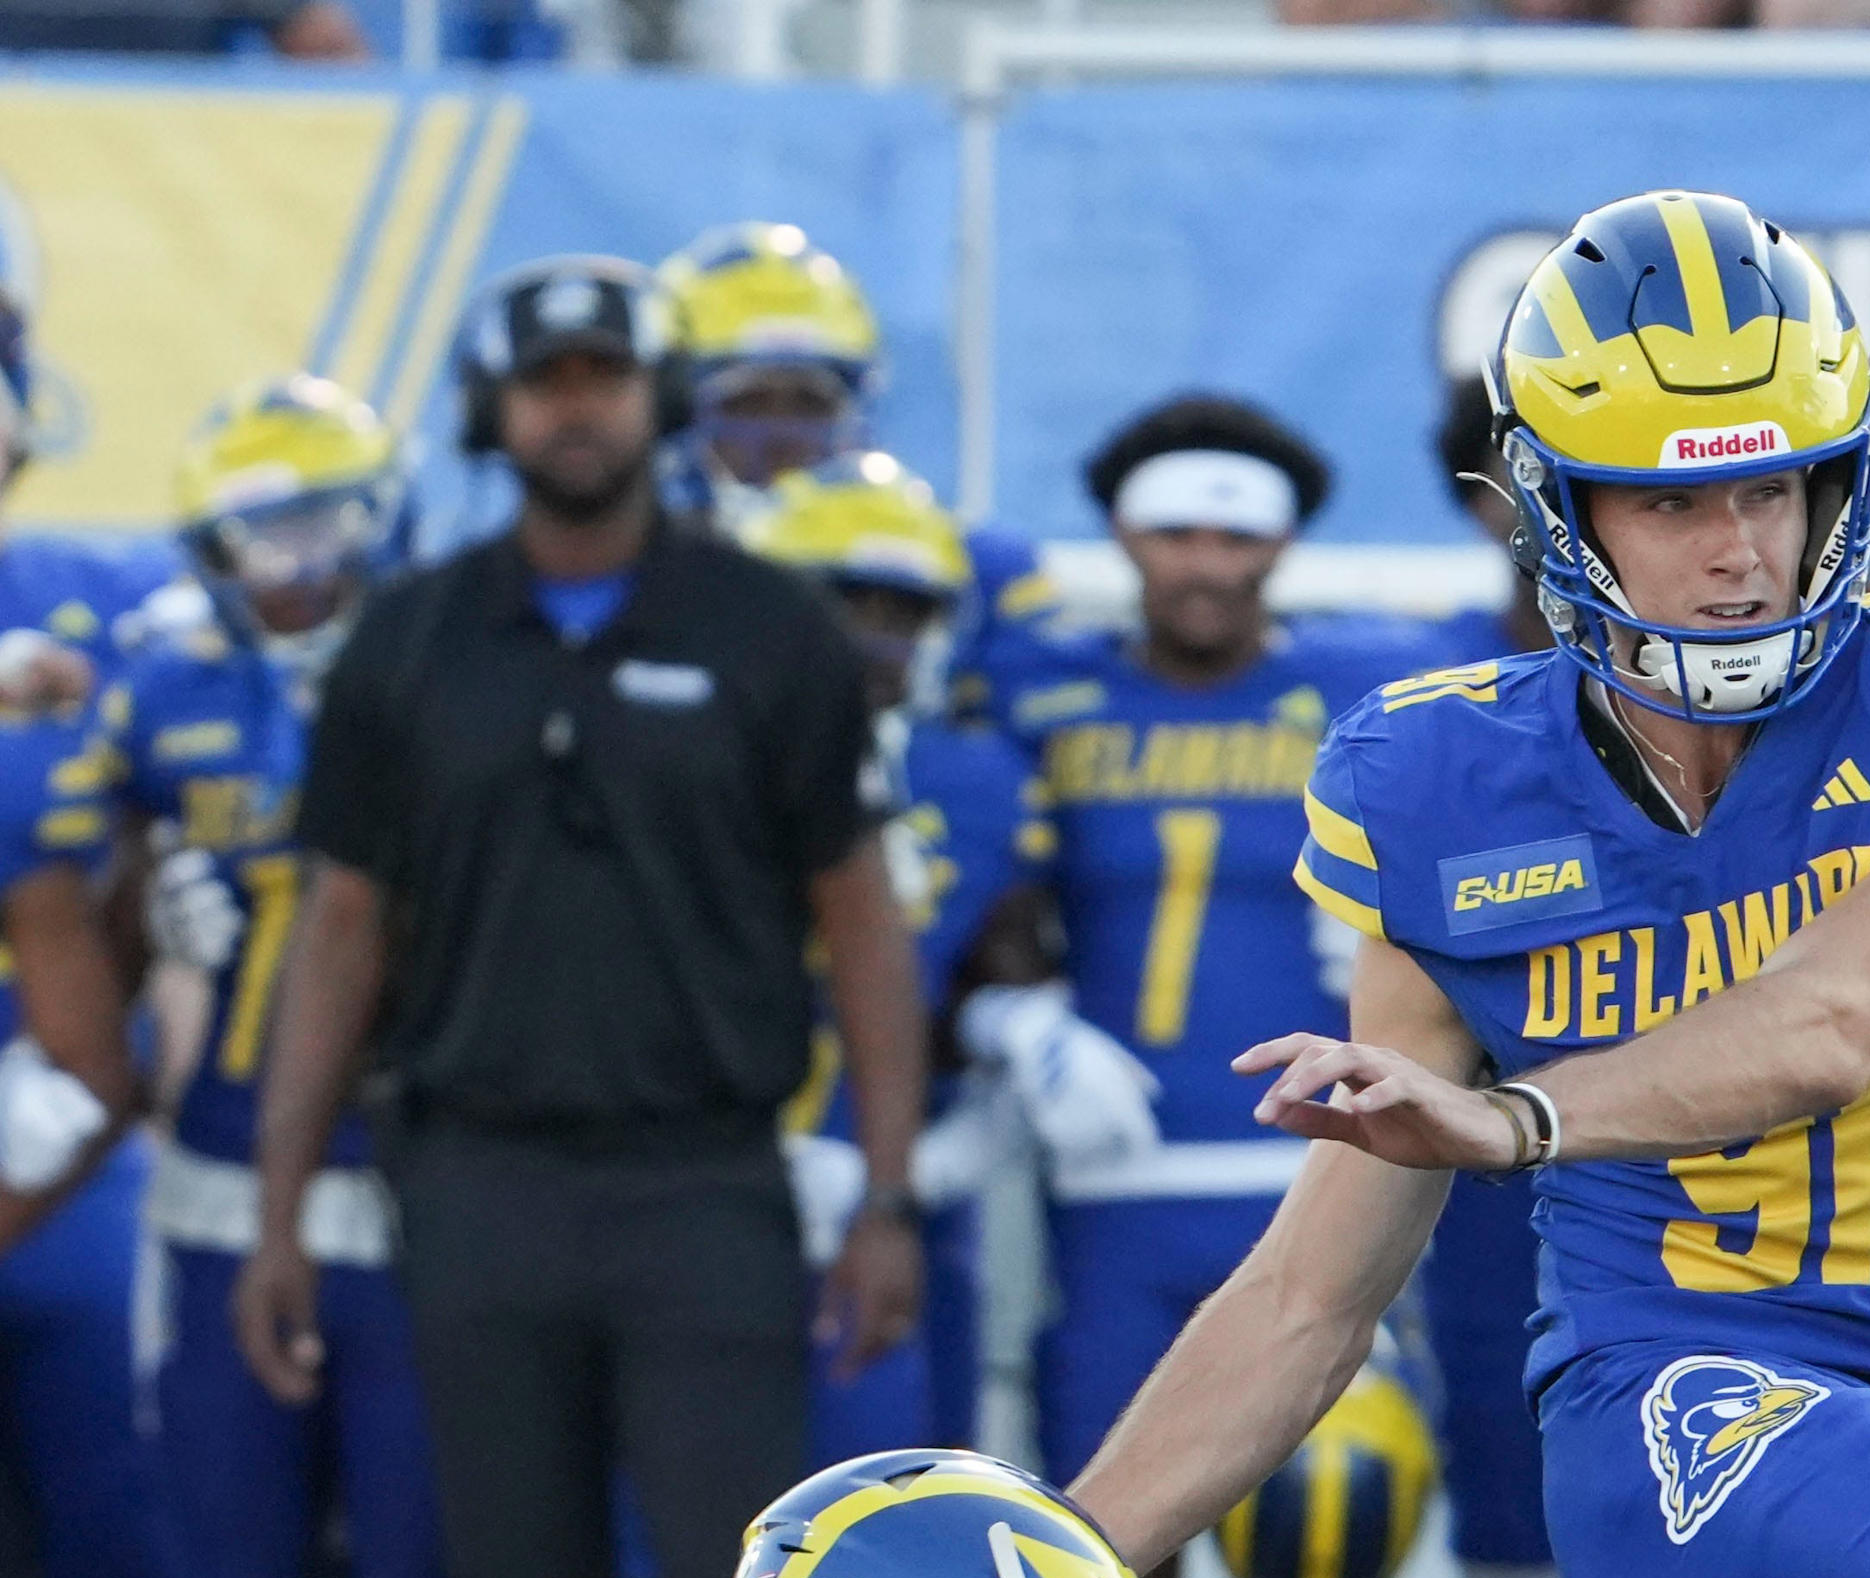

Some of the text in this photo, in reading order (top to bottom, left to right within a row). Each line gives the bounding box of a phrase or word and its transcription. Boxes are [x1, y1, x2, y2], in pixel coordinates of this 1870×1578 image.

[1676, 428, 1776, 460] Riddell
[1549, 523, 1615, 590] Ridell
[1820, 519, 1850, 571] Ridd
[1711, 655, 1761, 670] Riddell
[1134, 806, 1222, 1047] 1
